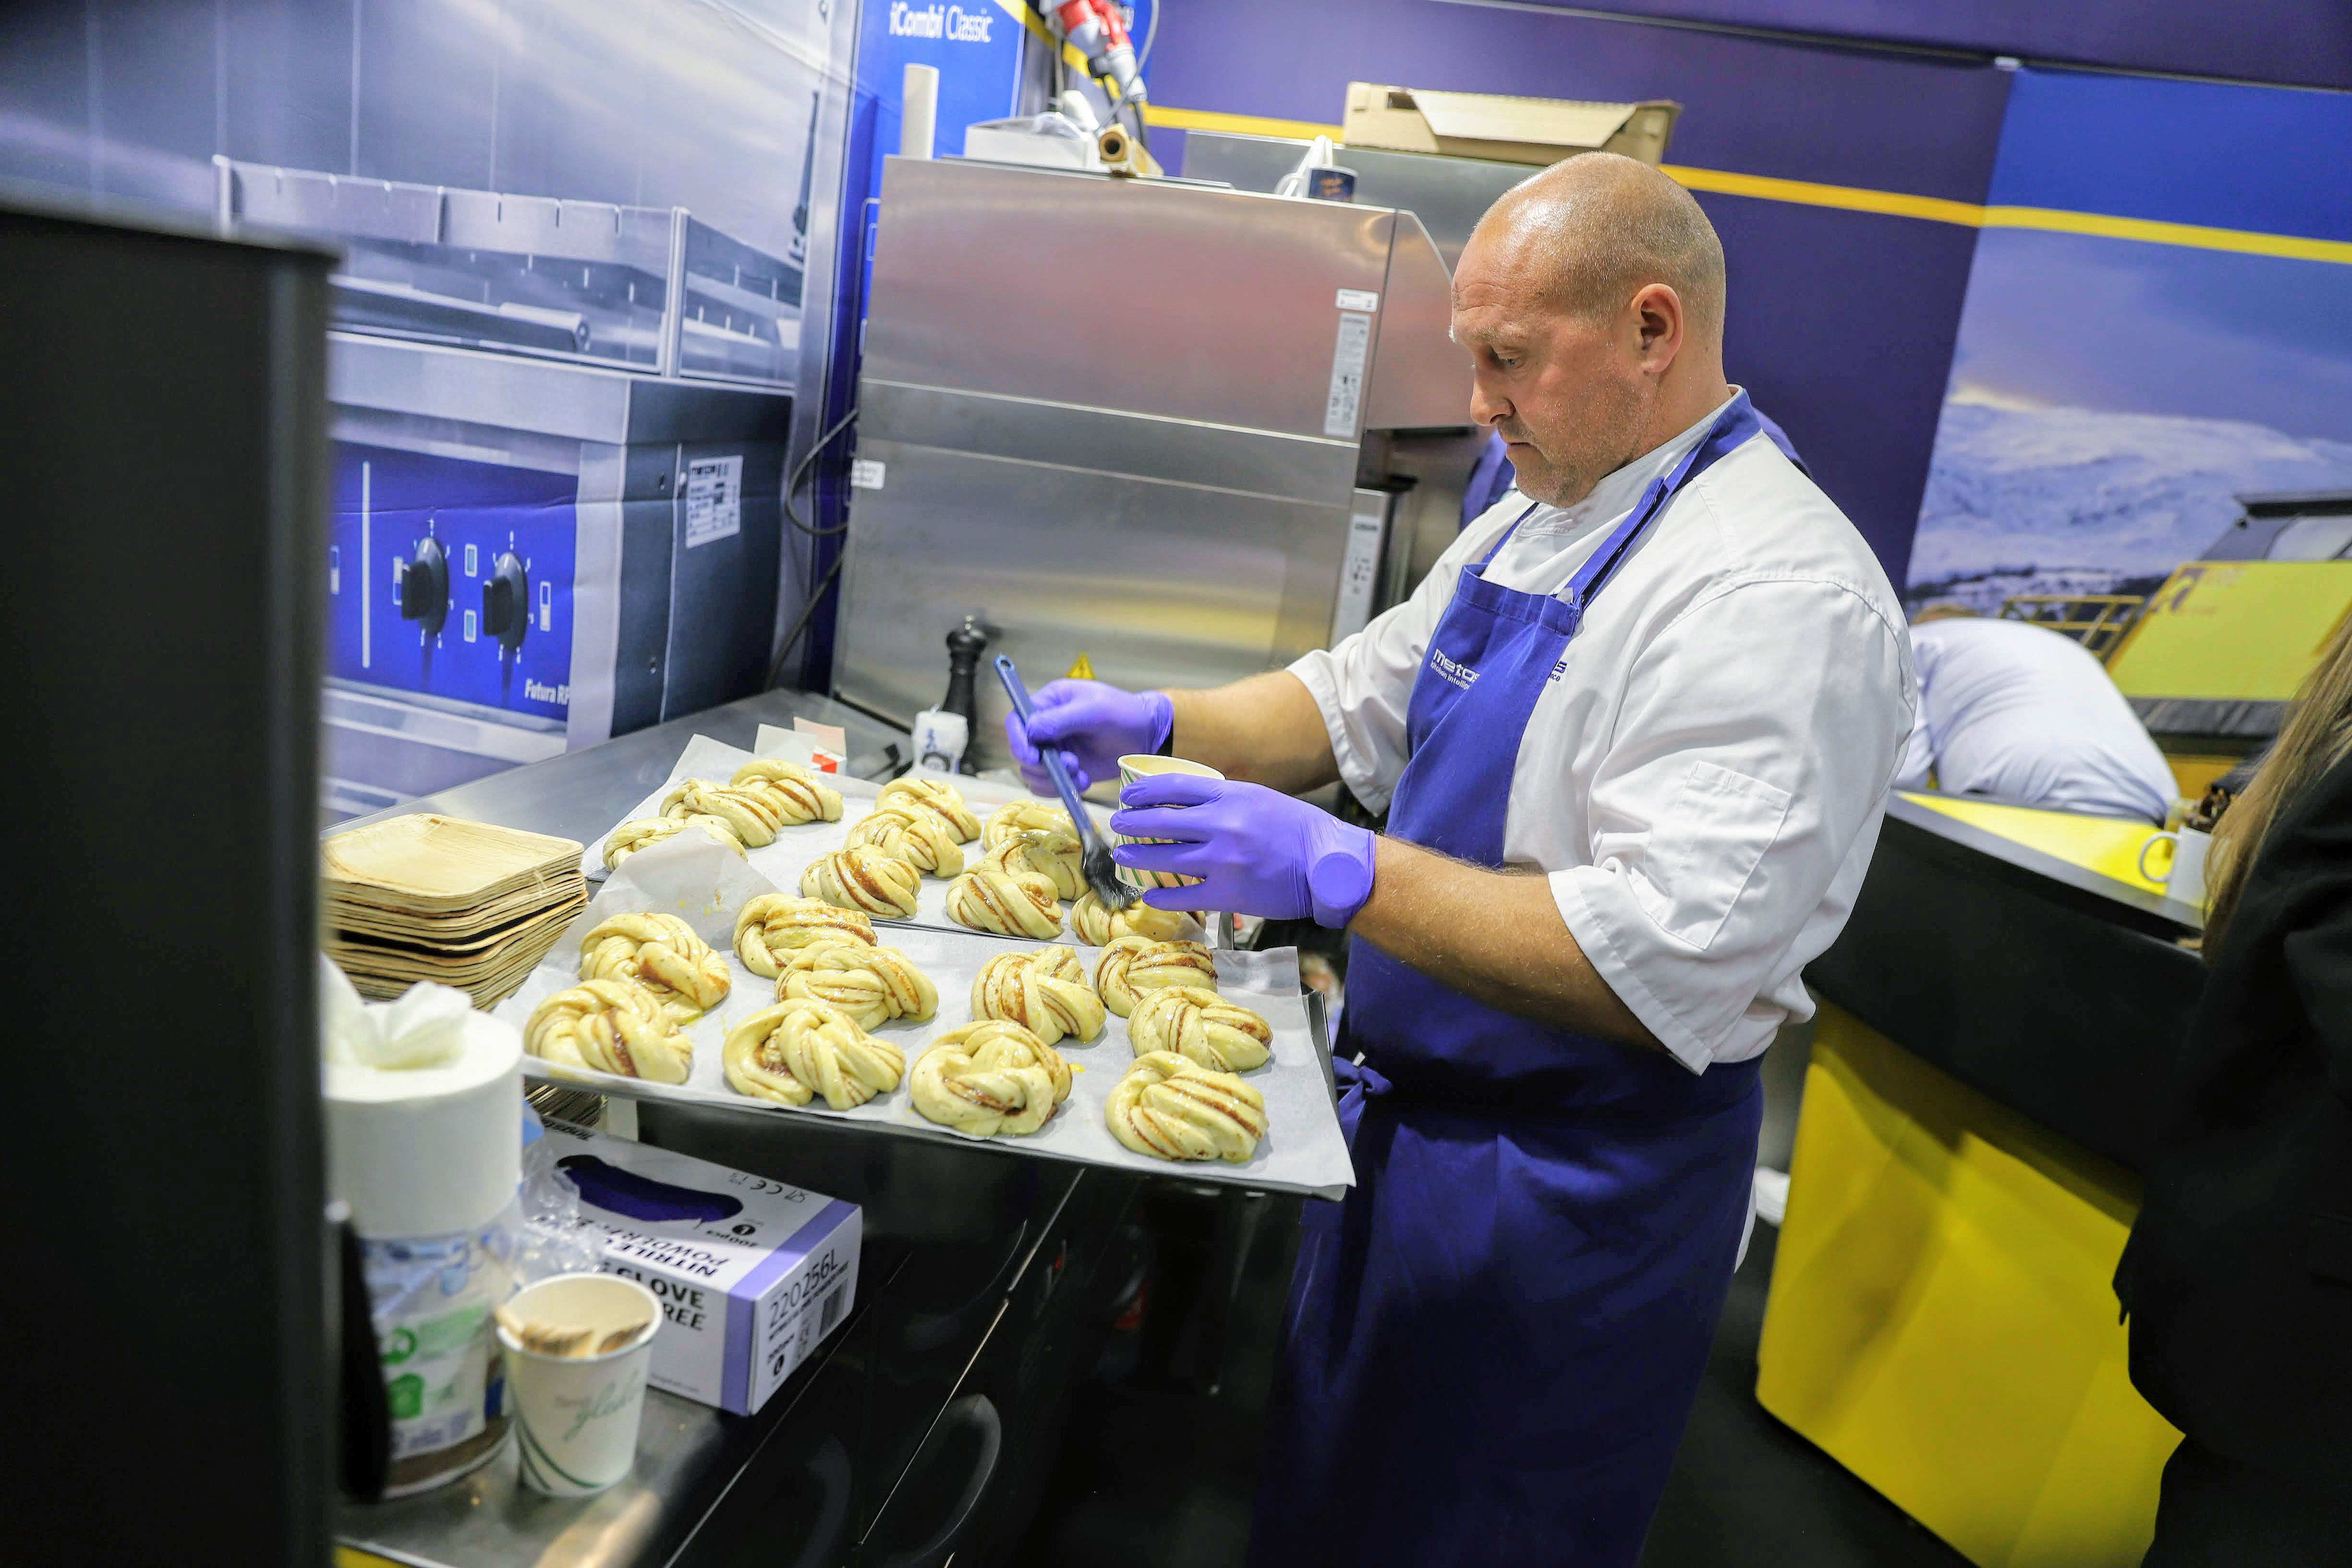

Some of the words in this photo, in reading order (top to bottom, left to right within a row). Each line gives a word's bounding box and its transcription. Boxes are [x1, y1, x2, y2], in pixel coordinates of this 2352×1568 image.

[889, 1, 945, 38] iCombi
[946, 4, 994, 43] Classic
[524, 678, 557, 703] Futura
[769, 1249, 838, 1328] 220256L
[662, 1301, 707, 1331] REE
